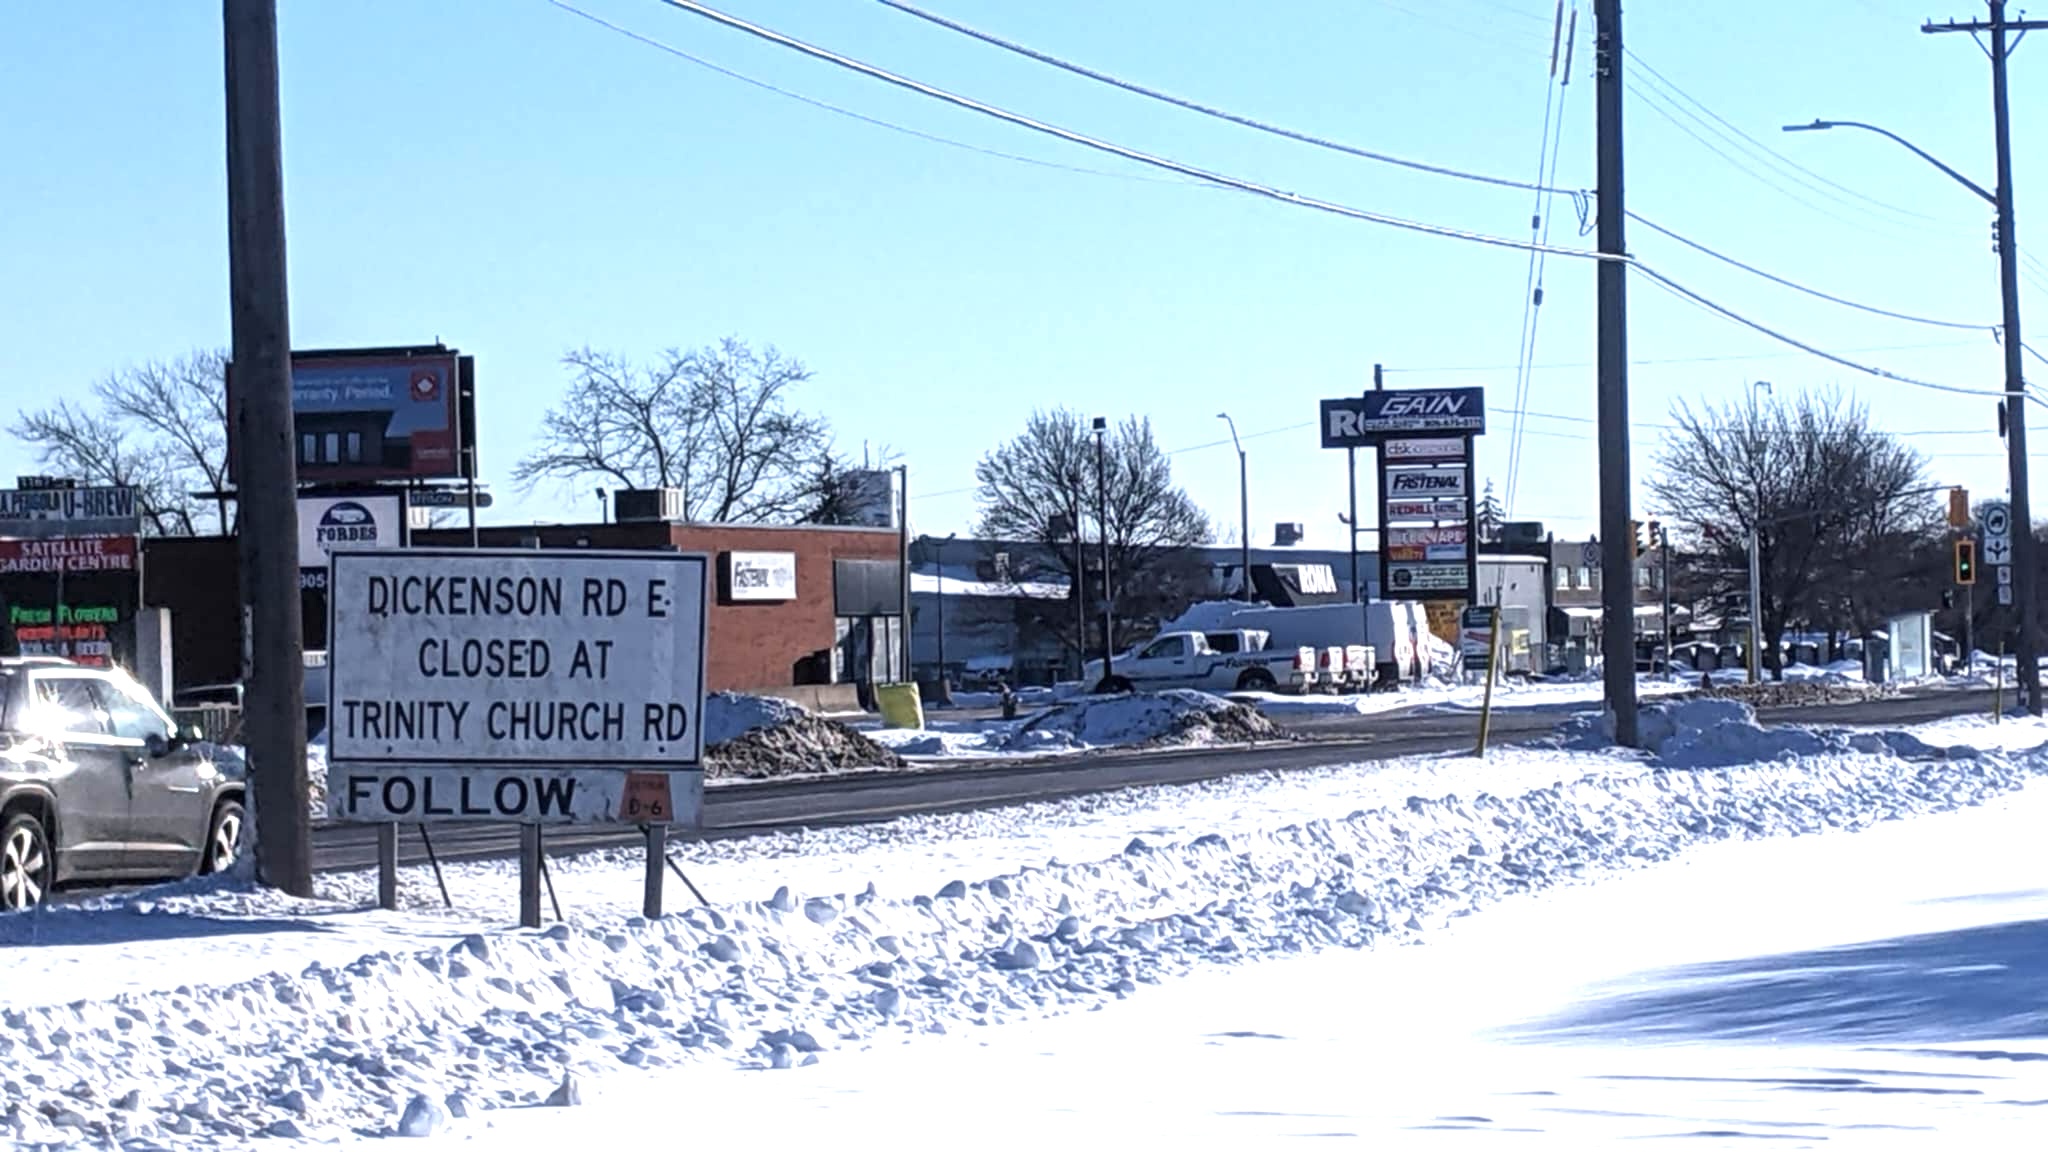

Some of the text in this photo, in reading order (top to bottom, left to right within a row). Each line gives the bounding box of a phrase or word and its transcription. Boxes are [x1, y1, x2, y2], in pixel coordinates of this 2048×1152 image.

[1379, 395, 1467, 416] GAIN
[1393, 473, 1460, 491] FASTENAL
[63, 488, 134, 519] U-BREW
[316, 526, 378, 543] FORBES
[21, 540, 104, 557] SATELLITE
[67, 554, 132, 571] CENTRE
[1298, 565, 1338, 594] RONA
[369, 575, 562, 617] DICKENSON
[583, 578, 627, 617] RD
[418, 638, 613, 679] CLOSED AT
[342, 700, 687, 742] TRINITY CHURCH RD
[348, 775, 577, 816] FOLLOW
[628, 798, 663, 816] D-6
